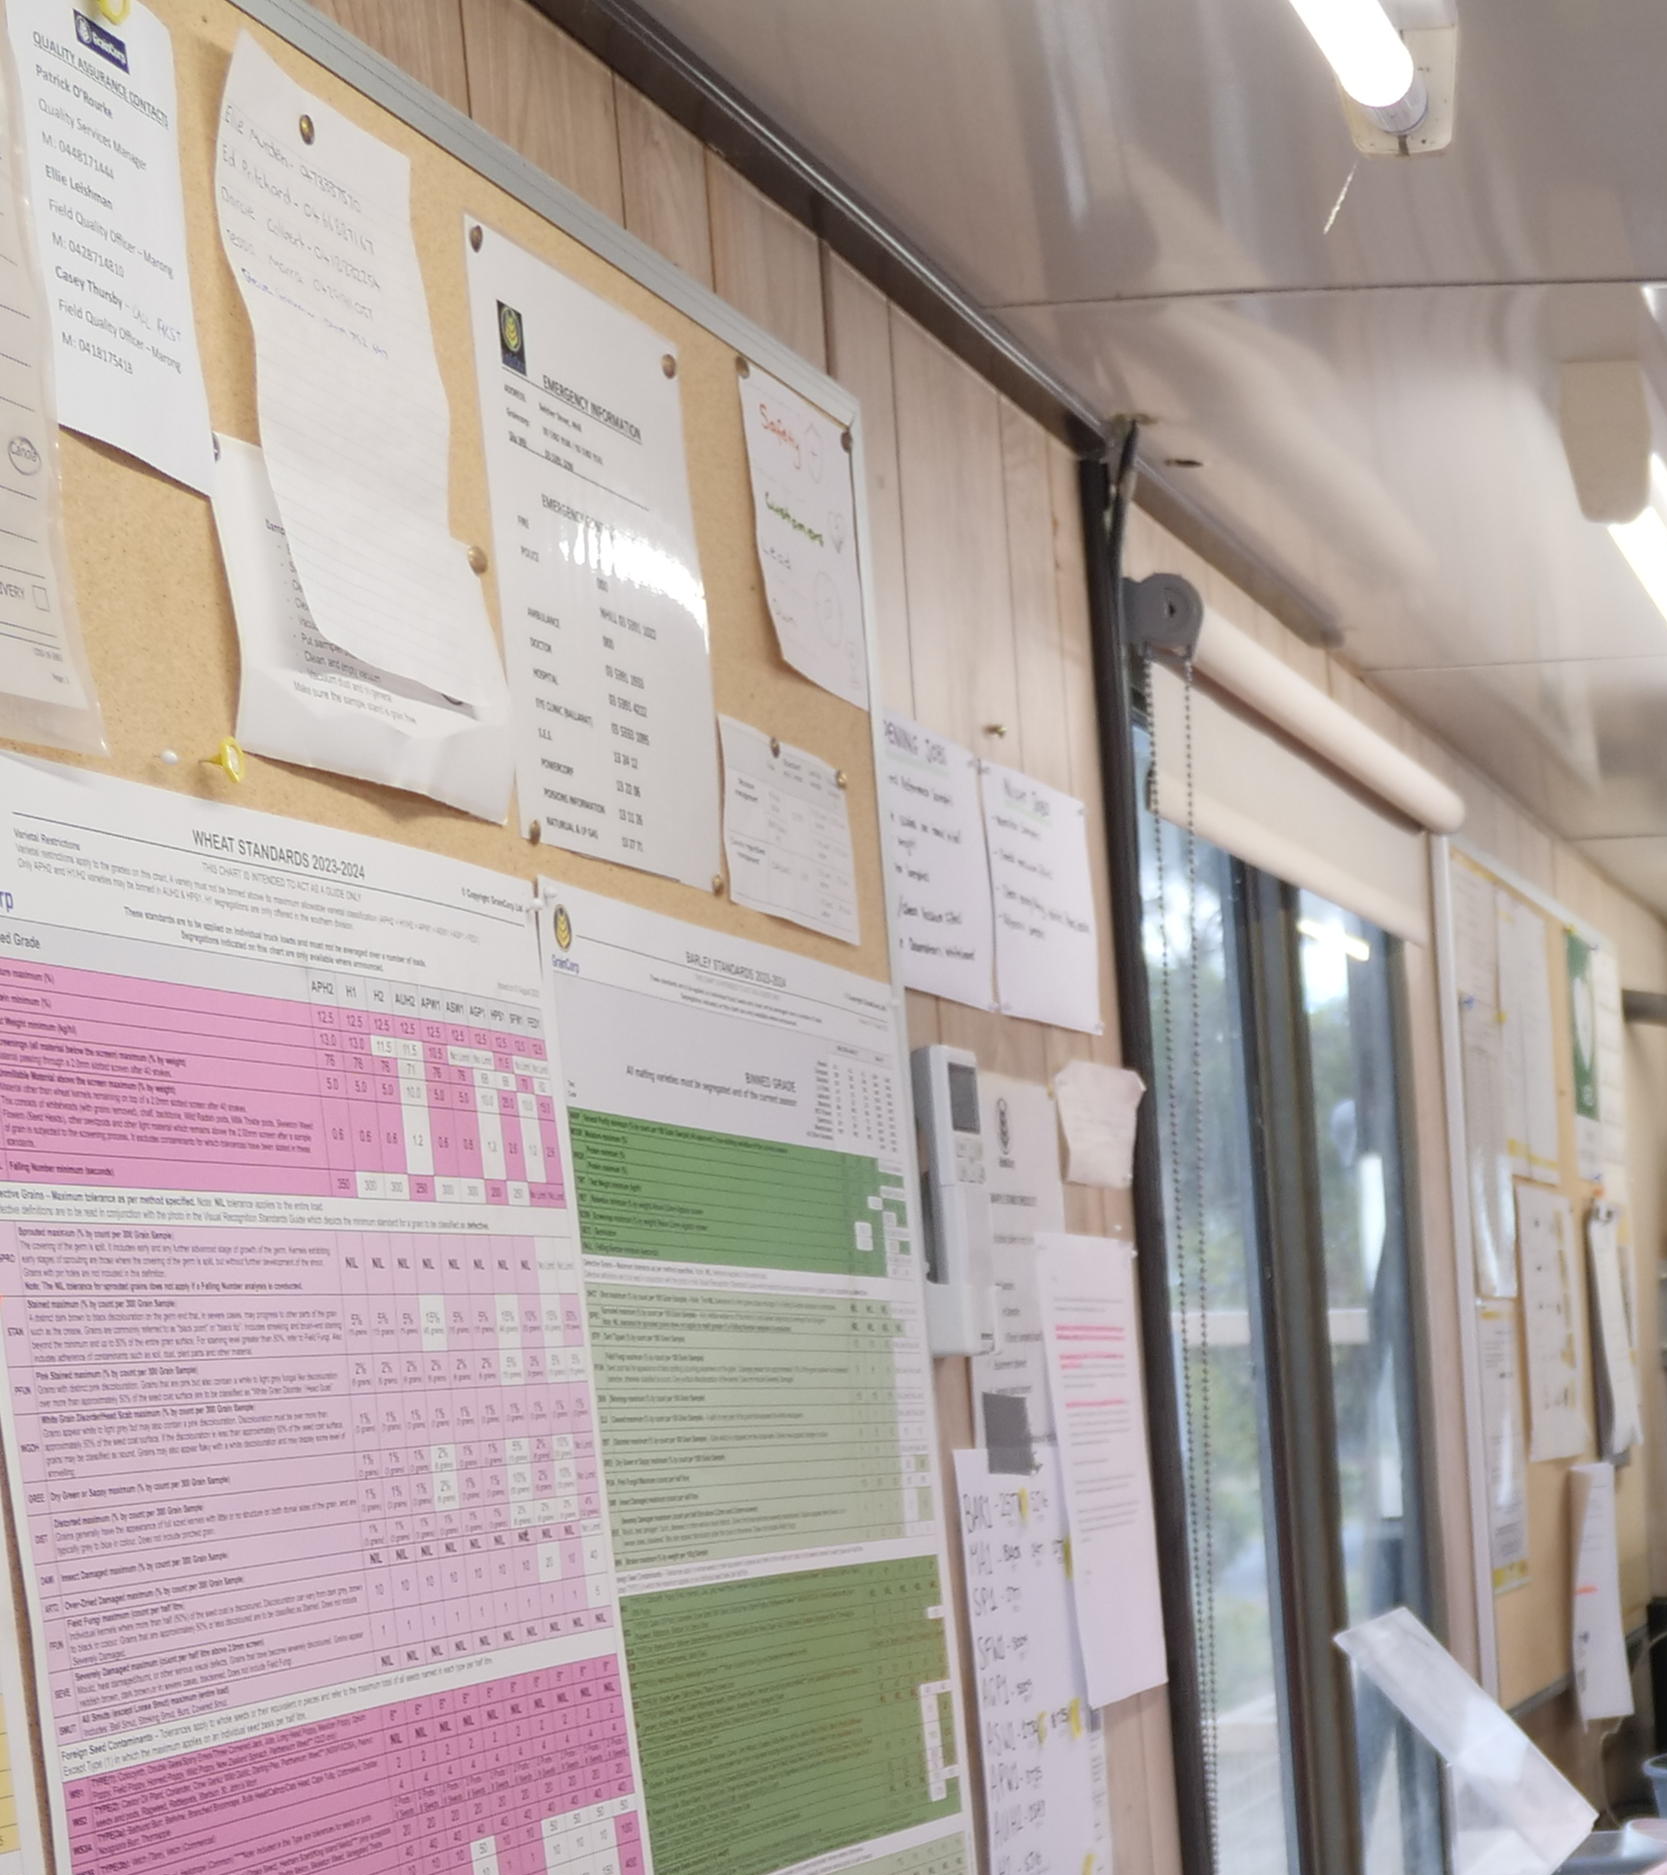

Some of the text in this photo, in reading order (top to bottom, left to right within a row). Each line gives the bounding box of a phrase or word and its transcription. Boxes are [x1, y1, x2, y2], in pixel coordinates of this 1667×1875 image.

[33, 31, 168, 129] QUALITY ASSURANCE CONTACTS
[35, 64, 70, 92] Patrick
[38, 98, 74, 128] Quality
[76, 118, 111, 148] Services
[45, 164, 113, 210] Ellie Leishman
[49, 198, 73, 220] Field
[75, 211, 107, 240] Quality
[110, 229, 136, 254] Officer
[55, 265, 123, 310] Casey Thursby
[58, 298, 144, 350] Field Quality Officer
[543, 374, 642, 441] EMERGENCY INFORMATION
[759, 403, 801, 470] Safety
[192, 828, 365, 880] WHEAT STANDARDS 2023-2024
[14, 932, 40, 950] Grade
[686, 951, 711, 969] BARLEY
[712, 957, 754, 981] STANDARDS
[311, 981, 334, 995] APH2
[346, 986, 357, 998] H1
[374, 990, 384, 1002] H2
[395, 993, 416, 1007] AUH2
[317, 1011, 334, 1024] 12.5
[346, 1015, 363, 1027] 12.5
[374, 1018, 390, 1031] 12.5
[400, 1021, 415, 1035] 12.5
[376, 1040, 391, 1053] 11.5
[327, 1077, 339, 1090] 5.0
[773, 1076, 796, 1093] GRADE
[413, 1134, 424, 1146] 1.2
[345, 1257, 359, 1269] NIL
[372, 1257, 385, 1269] NIL
[398, 1257, 411, 1270] NIL
[423, 1257, 435, 1270] NIL
